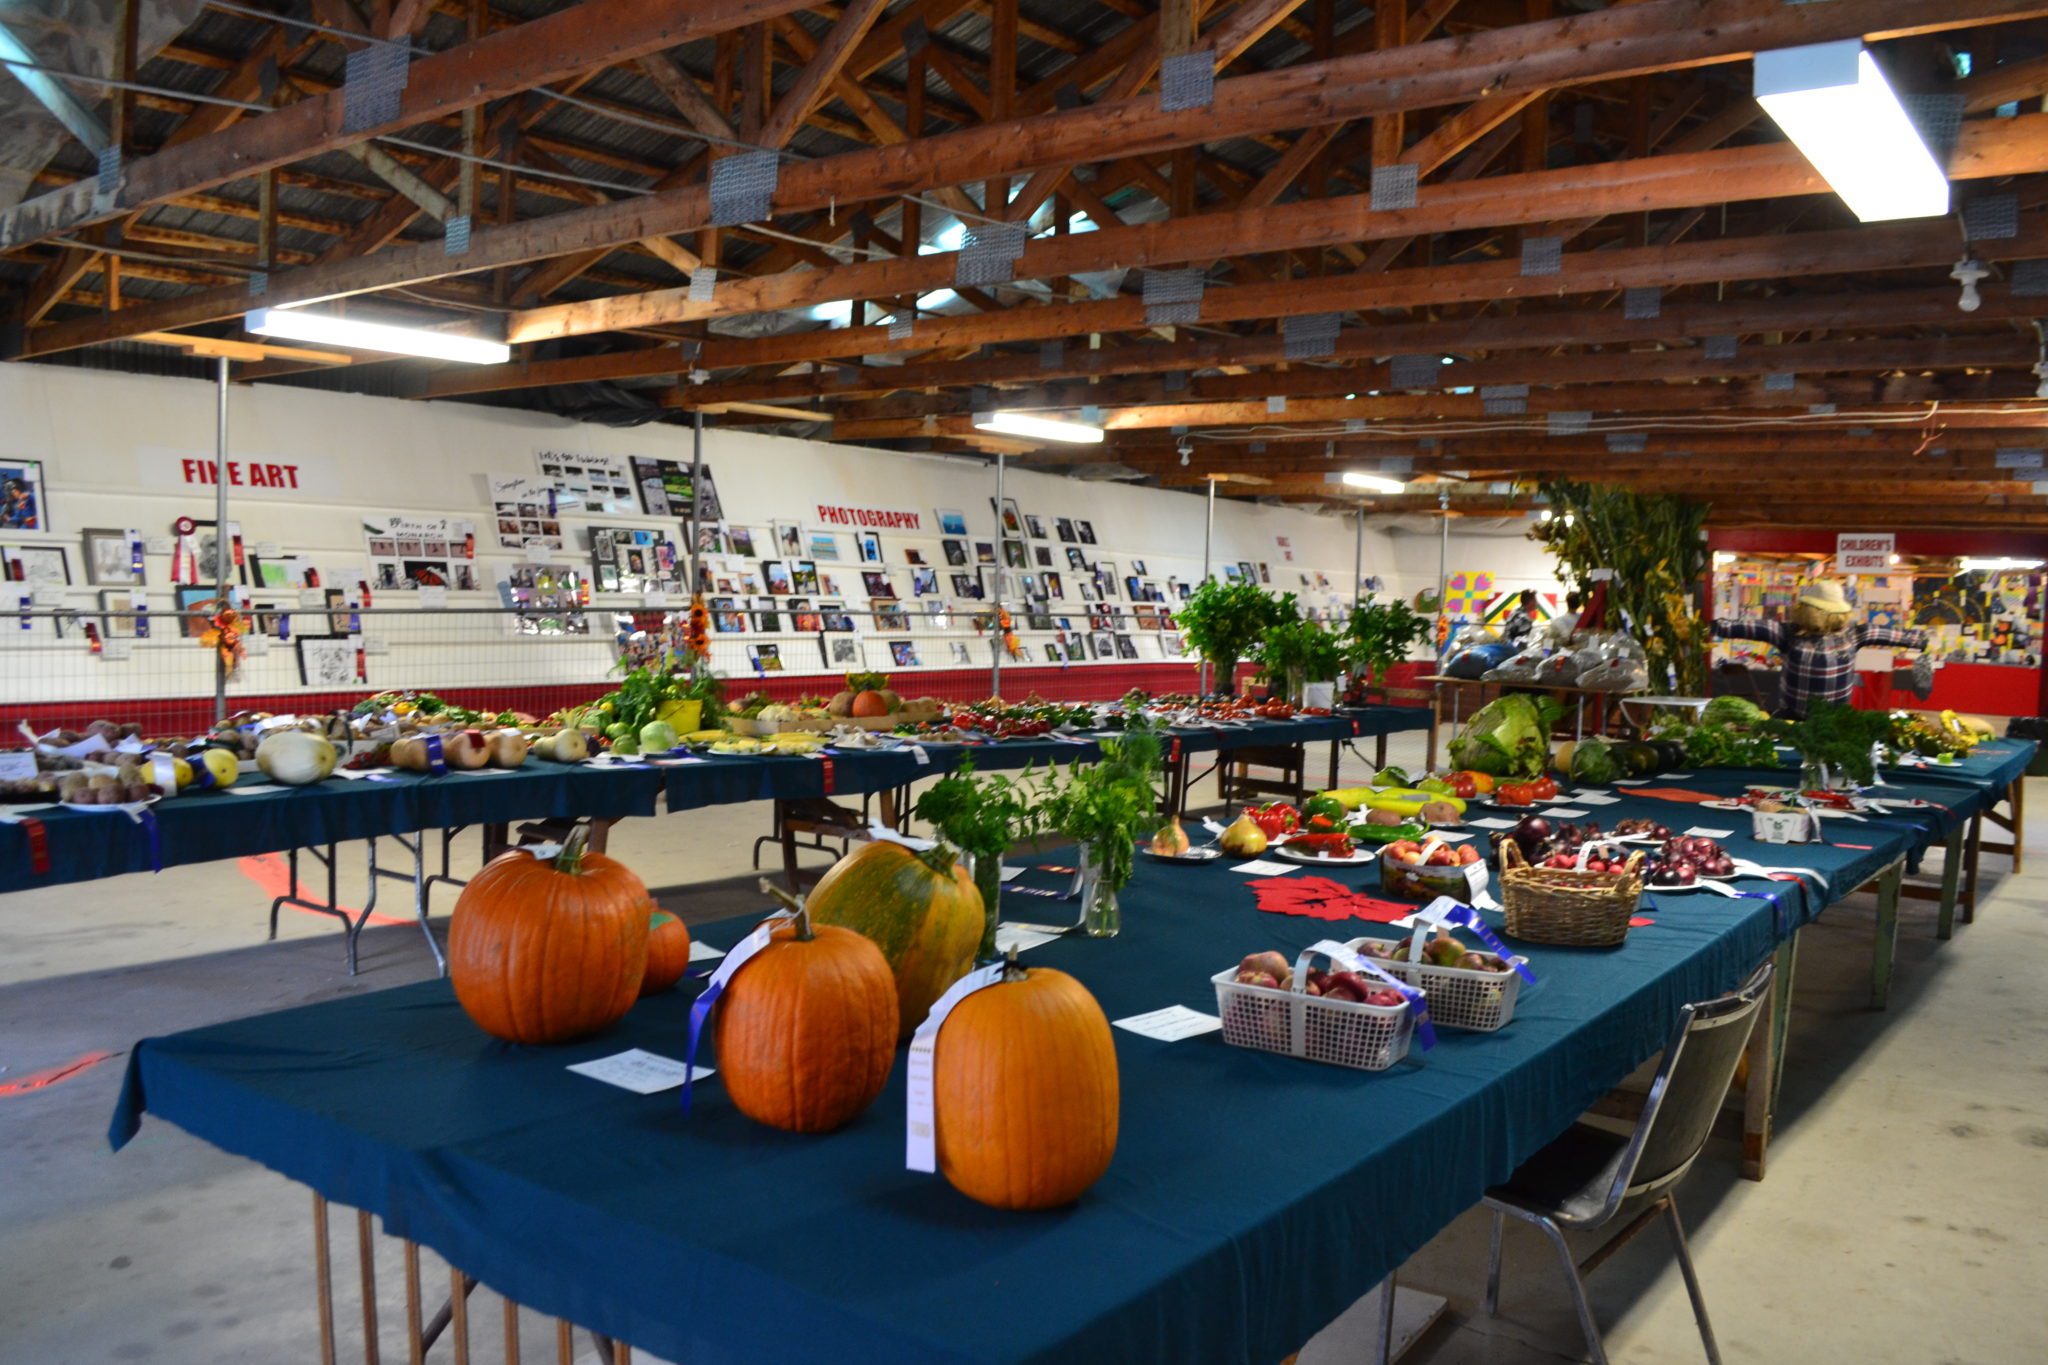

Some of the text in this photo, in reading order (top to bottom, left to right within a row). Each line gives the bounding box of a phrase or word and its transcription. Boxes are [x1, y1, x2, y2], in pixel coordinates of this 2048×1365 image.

[249, 463, 298, 489] ART
[818, 504, 920, 529] PHOTOGRAPHY
[1840, 539, 1892, 551] CHILDREN'S
[1845, 555, 1885, 568] EXHIBITS
